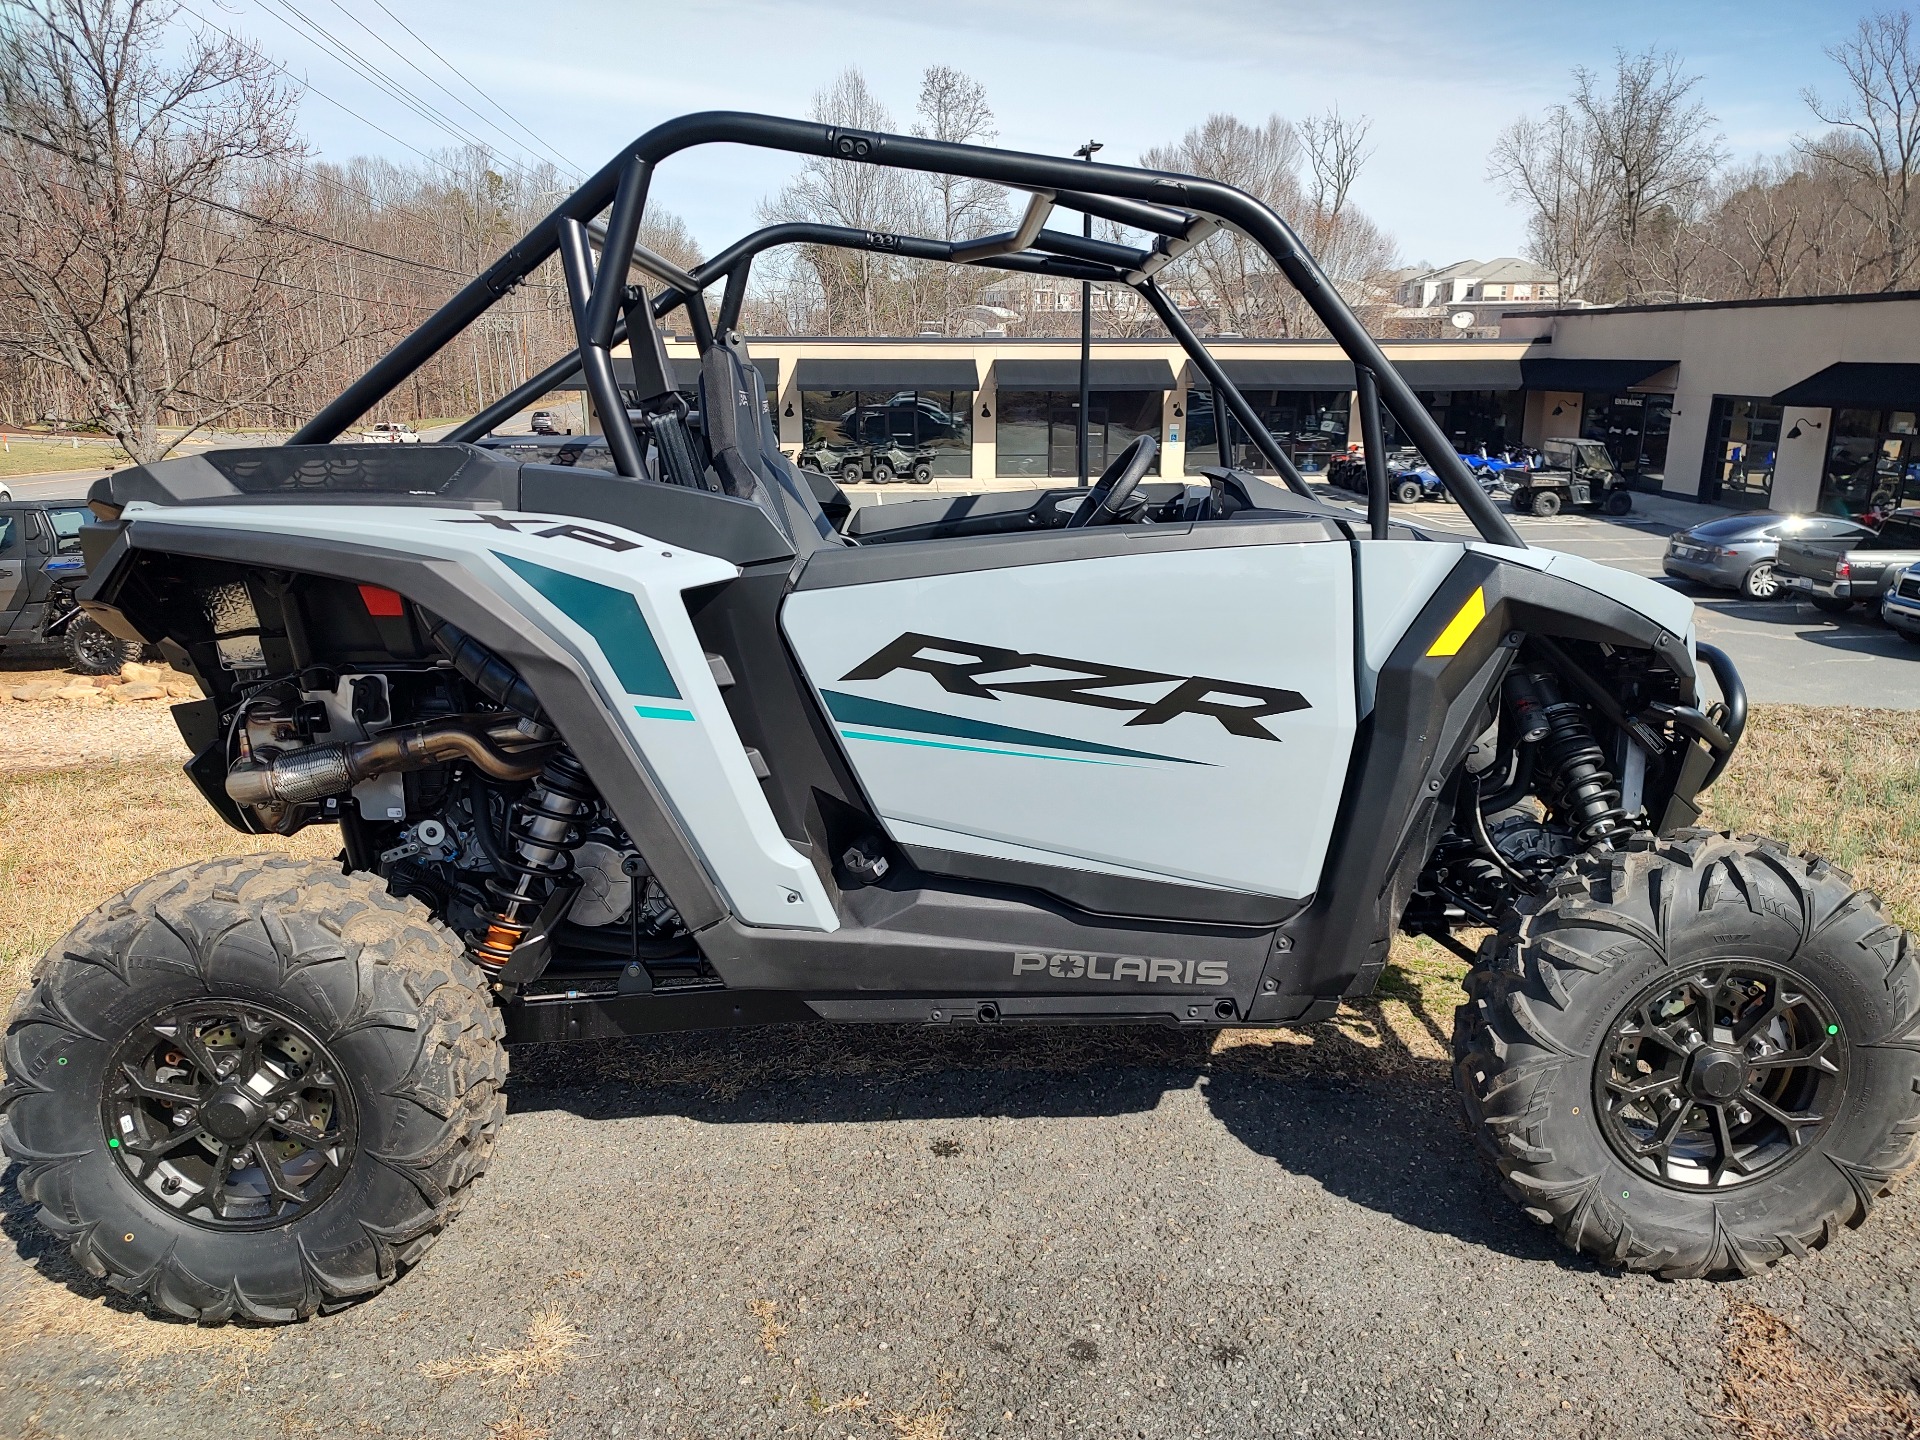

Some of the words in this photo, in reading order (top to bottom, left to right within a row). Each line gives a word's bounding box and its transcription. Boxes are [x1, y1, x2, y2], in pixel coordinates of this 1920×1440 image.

[1614, 398, 1643, 407] ENTRANCE
[435, 513, 644, 552] XP
[837, 631, 1313, 742] RZR
[1012, 952, 1229, 986] POLARIS
